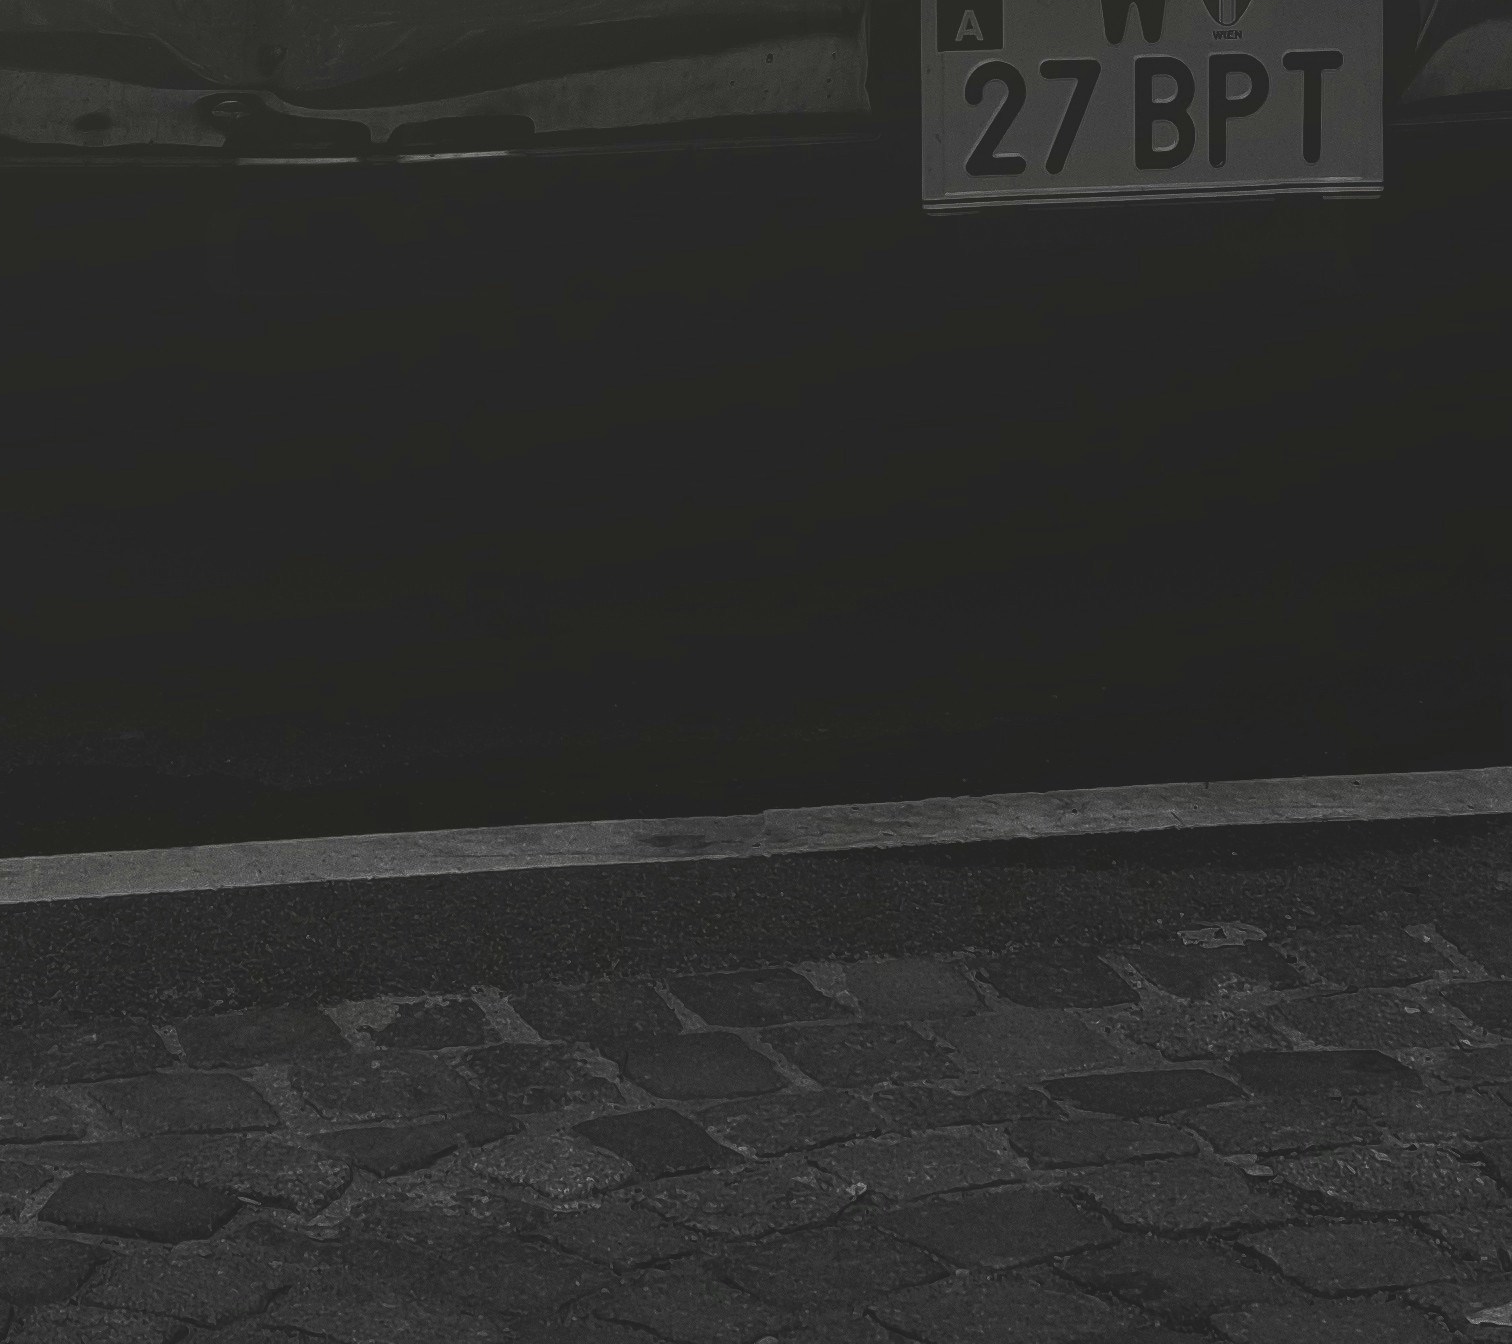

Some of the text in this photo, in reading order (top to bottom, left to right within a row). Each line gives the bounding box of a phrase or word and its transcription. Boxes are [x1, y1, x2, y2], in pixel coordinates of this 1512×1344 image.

[954, 9, 985, 42] A
[963, 48, 1345, 177] 27 BPT
